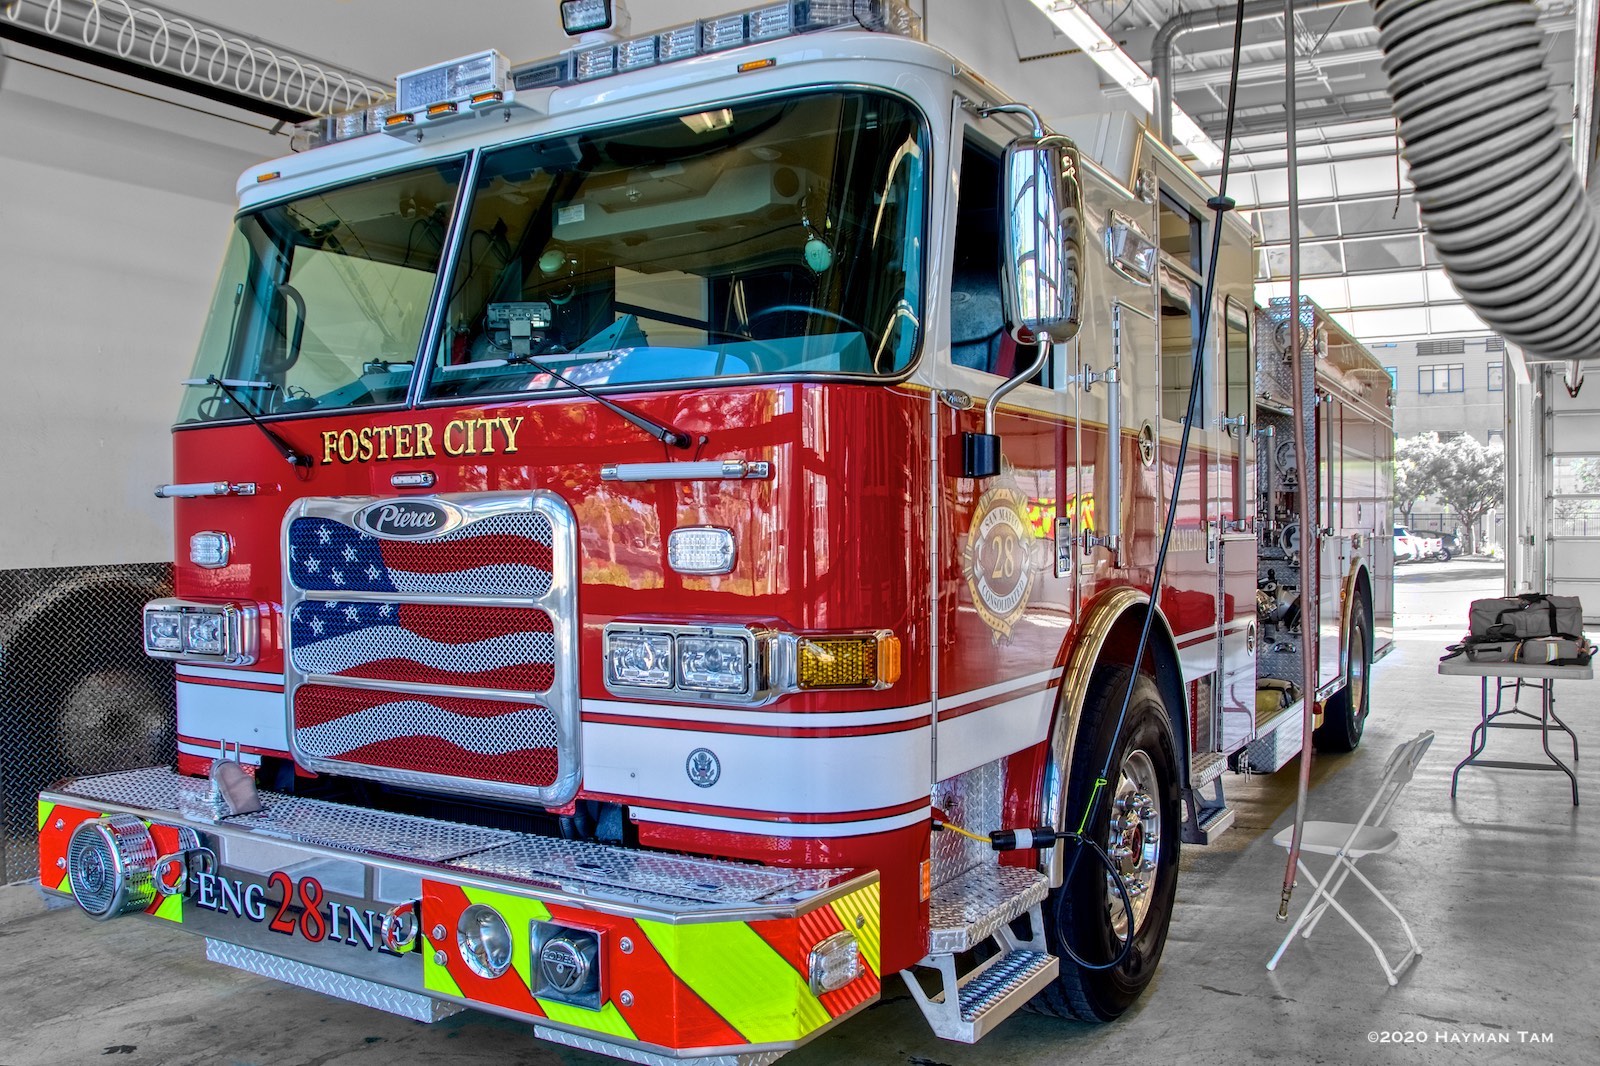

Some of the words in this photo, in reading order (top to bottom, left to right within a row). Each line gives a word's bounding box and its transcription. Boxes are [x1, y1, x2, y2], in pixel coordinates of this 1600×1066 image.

[321, 423, 436, 465] FOSTER
[443, 416, 524, 457] CITY
[378, 504, 437, 531] Pierce
[984, 510, 997, 531] SAN
[1162, 529, 1207, 552] RAMEDIC
[992, 534, 1015, 579] 28
[982, 580, 1024, 611] CONSOLIDATED
